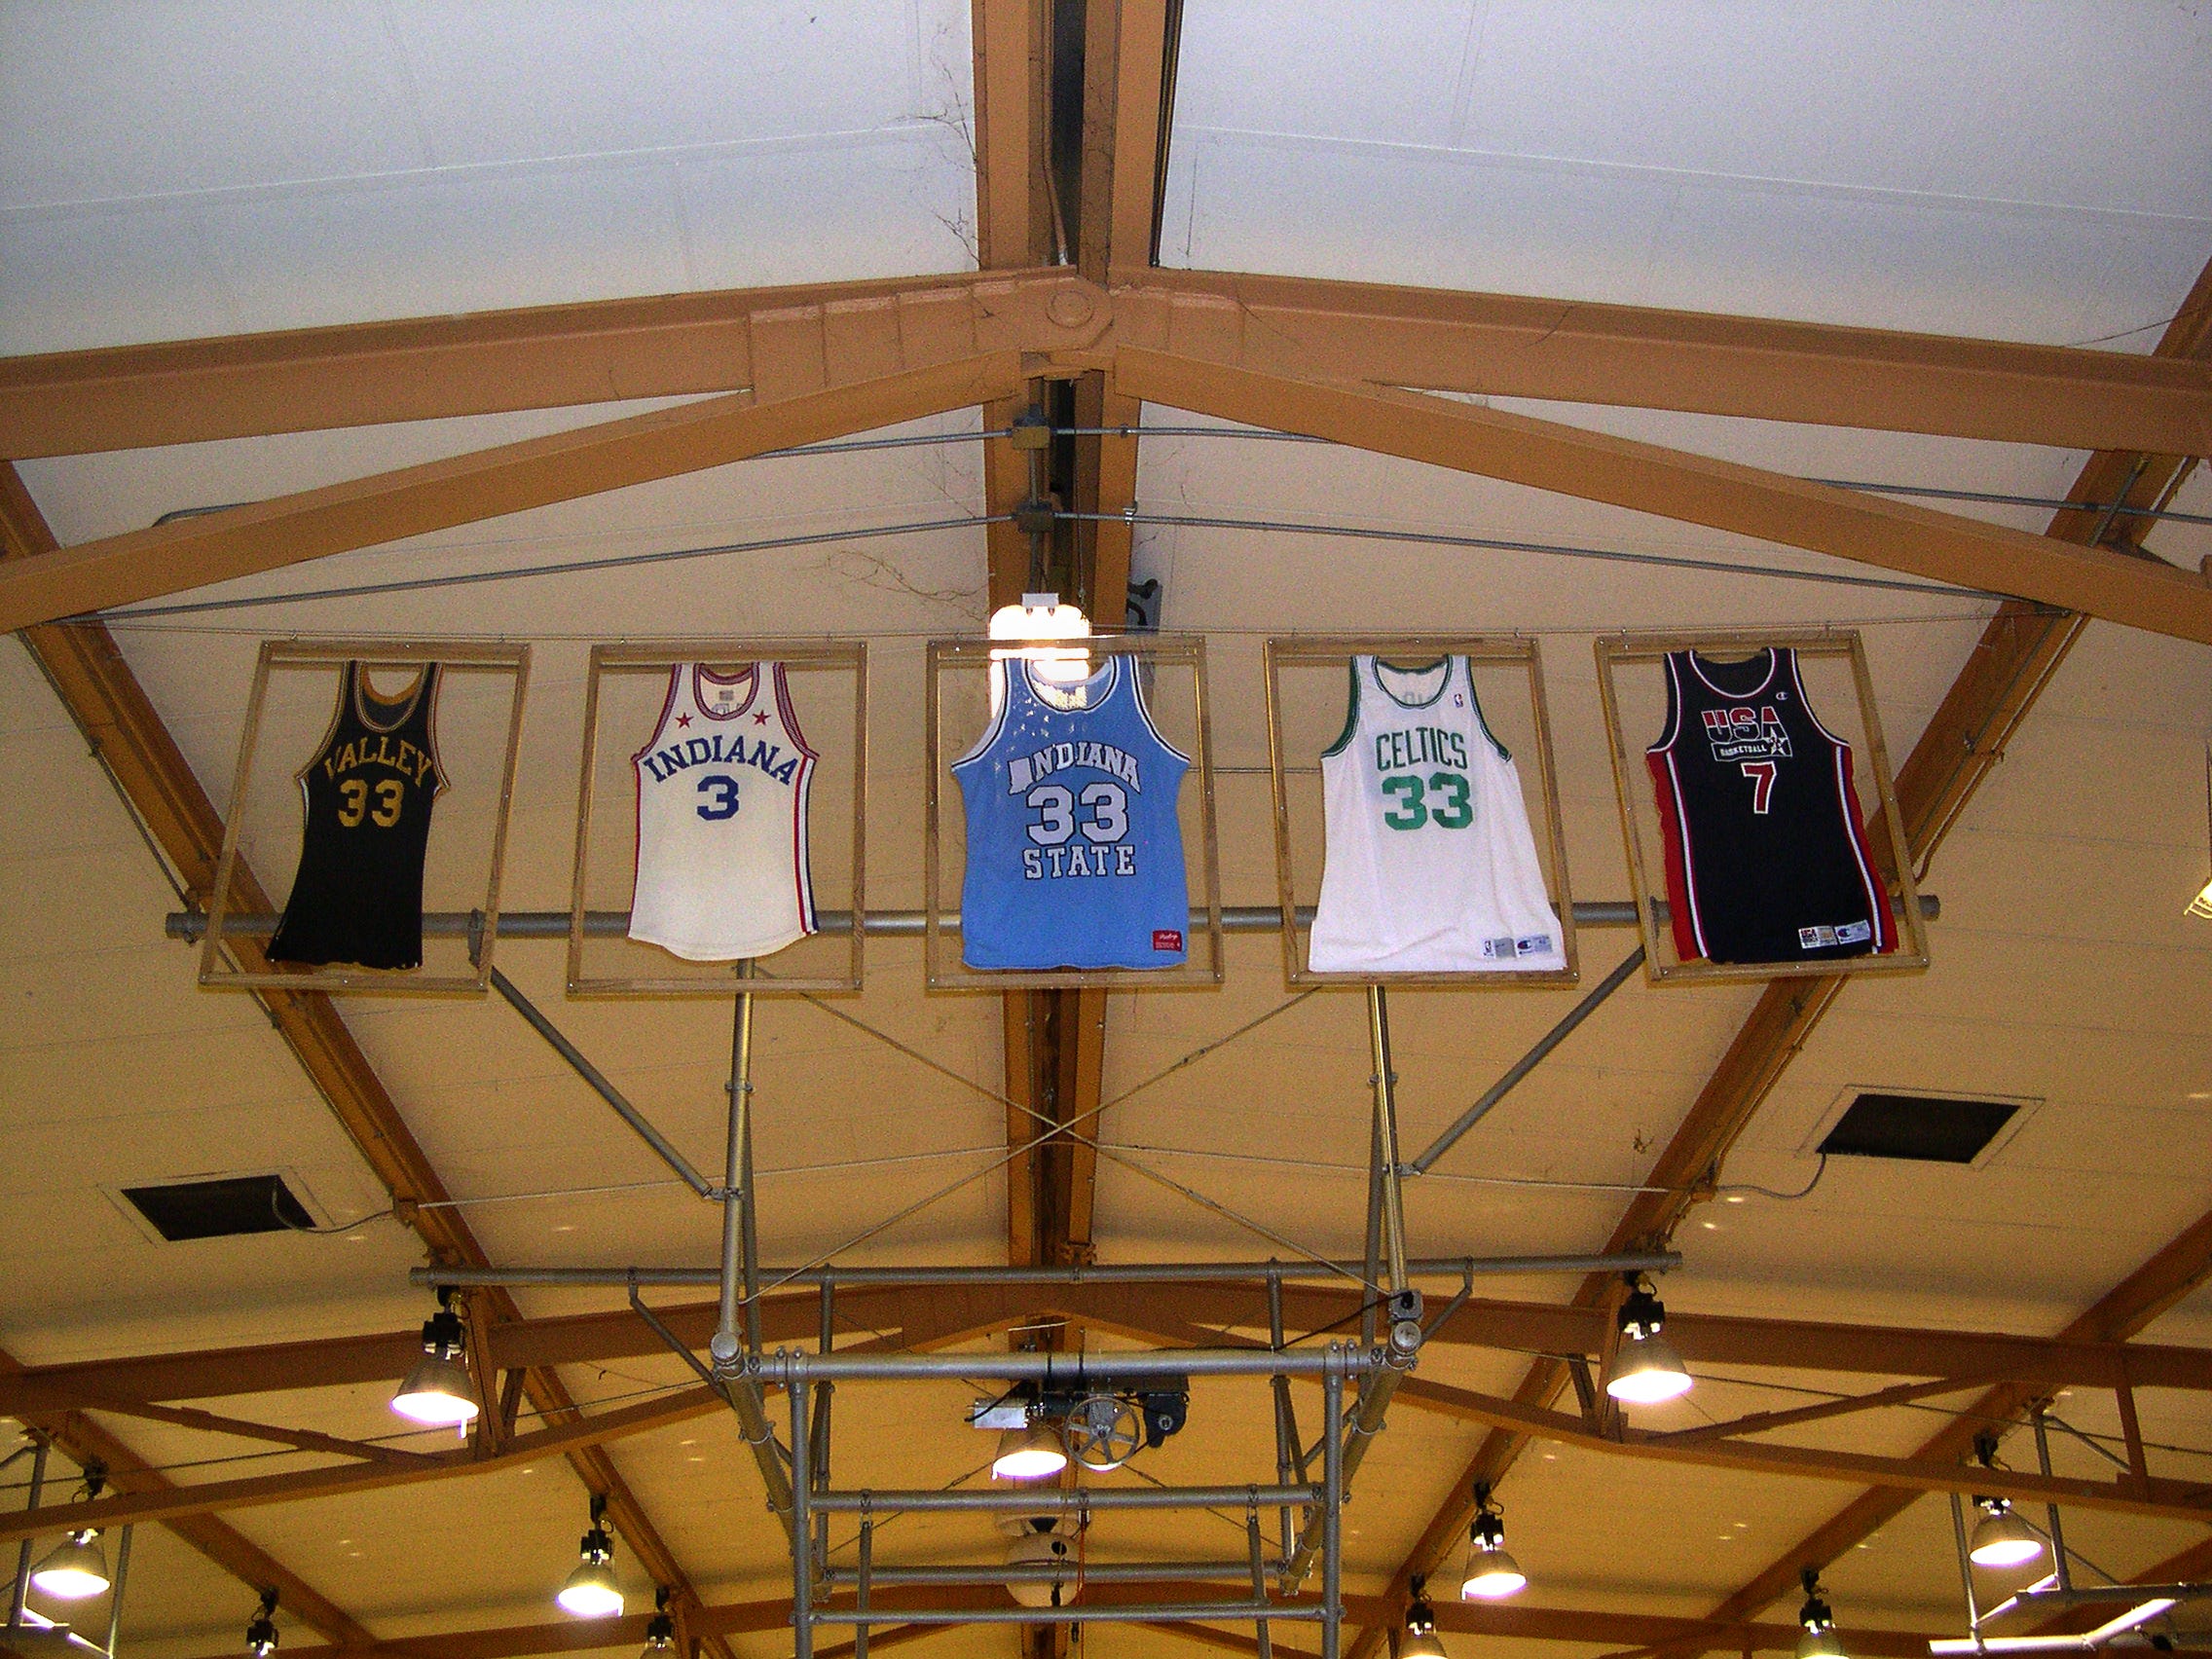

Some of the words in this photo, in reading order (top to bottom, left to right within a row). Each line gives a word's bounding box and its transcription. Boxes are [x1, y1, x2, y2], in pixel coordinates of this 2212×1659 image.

[1376, 726, 1467, 772] CELTICS
[1701, 706, 1788, 743] USA
[324, 736, 432, 788] VALLEY
[643, 734, 798, 786] INDIANA
[338, 779, 405, 828] 33
[697, 775, 740, 821] 3
[1381, 772, 1474, 830] 33
[1741, 761, 1777, 815] 7
[1026, 782, 1130, 847] 33
[1022, 845, 1136, 880] STATE
